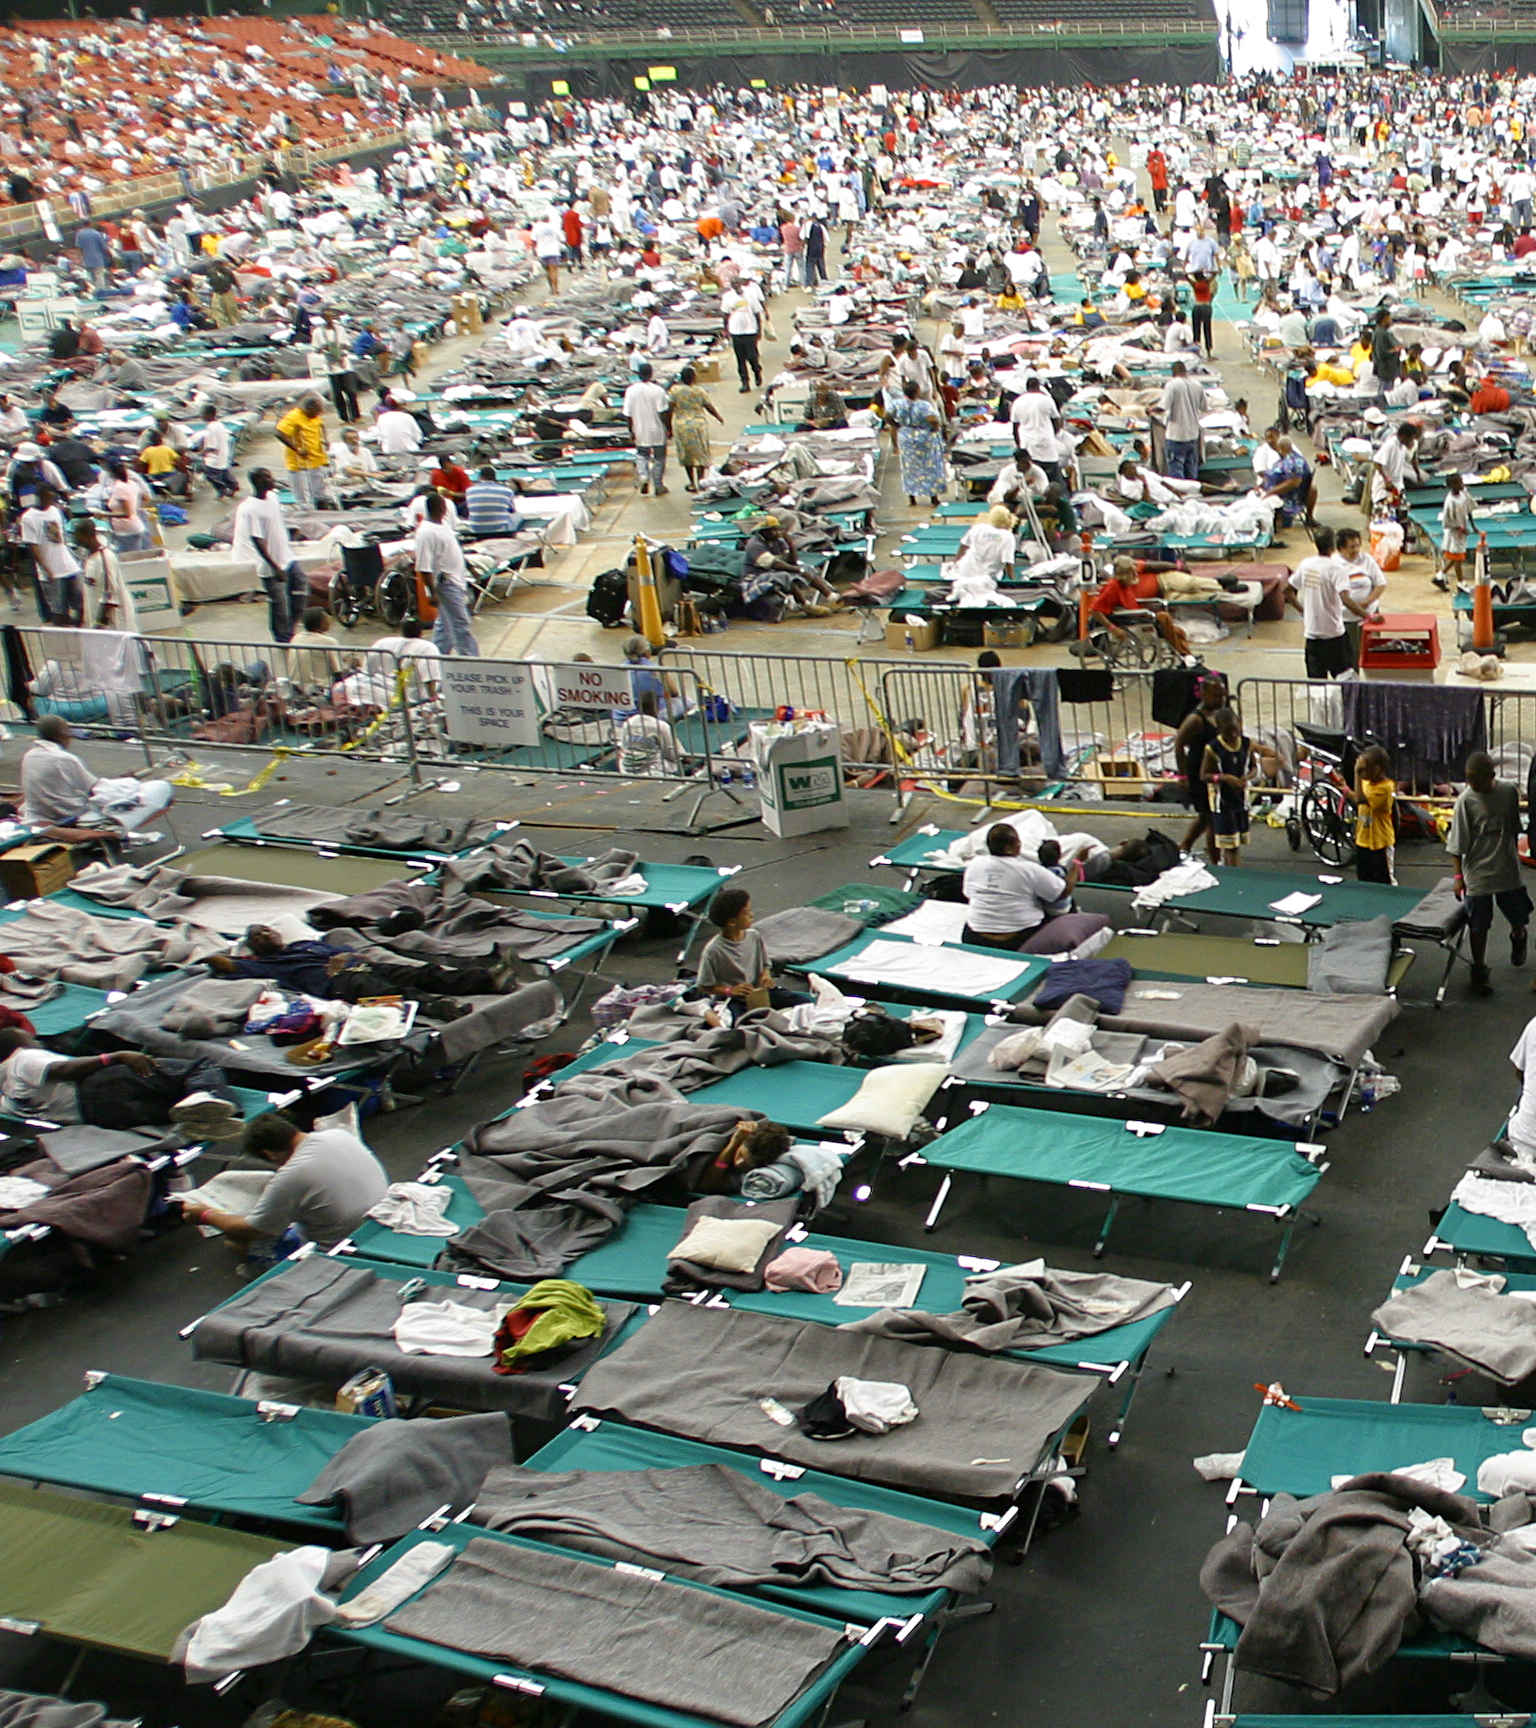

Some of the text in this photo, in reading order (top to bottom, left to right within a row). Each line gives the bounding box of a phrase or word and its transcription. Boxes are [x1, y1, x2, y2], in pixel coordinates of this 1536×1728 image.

[1082, 560, 1093, 581] D
[446, 672, 525, 685] PLEASE PICK UP
[579, 672, 602, 687] NO
[450, 684, 477, 694] YOUR
[480, 685, 512, 695] TRASH
[558, 688, 630, 706] SMOKING
[460, 706, 525, 718] THIS IS YOUR
[478, 718, 511, 728] SPACE
[788, 772, 833, 790] WM
